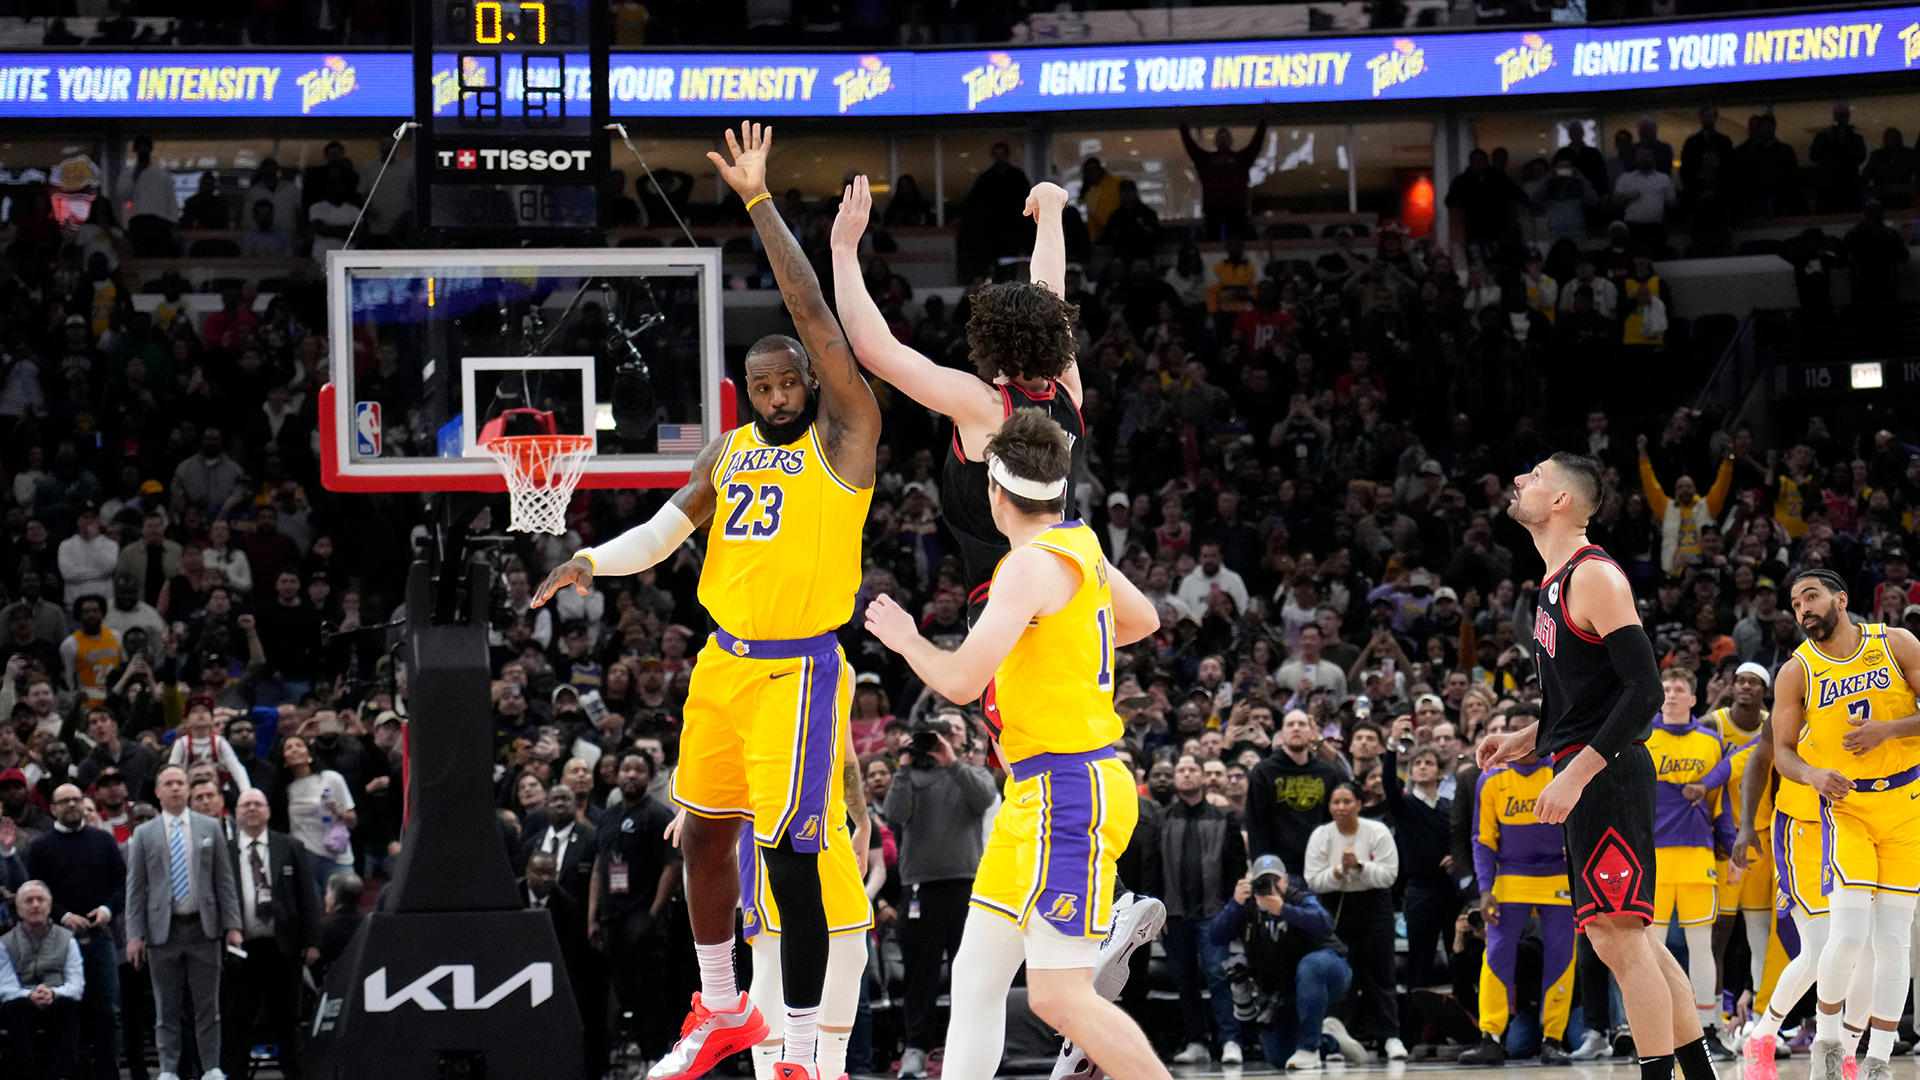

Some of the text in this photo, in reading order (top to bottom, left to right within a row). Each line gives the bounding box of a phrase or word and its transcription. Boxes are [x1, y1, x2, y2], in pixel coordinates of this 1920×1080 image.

[475, 1, 546, 45] 0.7
[1494, 43, 1553, 93] Takis
[1571, 22, 1883, 77] IGNITE YOUR INTENSITY
[57, 66, 132, 102] YOUR
[137, 66, 281, 102] INTENSITY
[296, 66, 356, 114] Takis
[679, 67, 819, 101] INTENSITY
[833, 66, 891, 113] Takis
[962, 62, 1020, 110] Takis
[1038, 52, 1352, 96] IGNITE YOUR INTENSITY
[1366, 48, 1424, 97] Takis
[480, 149, 592, 171] TISSOT
[719, 446, 806, 491] LAKERS
[723, 482, 785, 541] 23
[1817, 665, 1892, 710] LAKERS
[1846, 697, 1872, 720] 7
[1658, 754, 1706, 775] LAKERS
